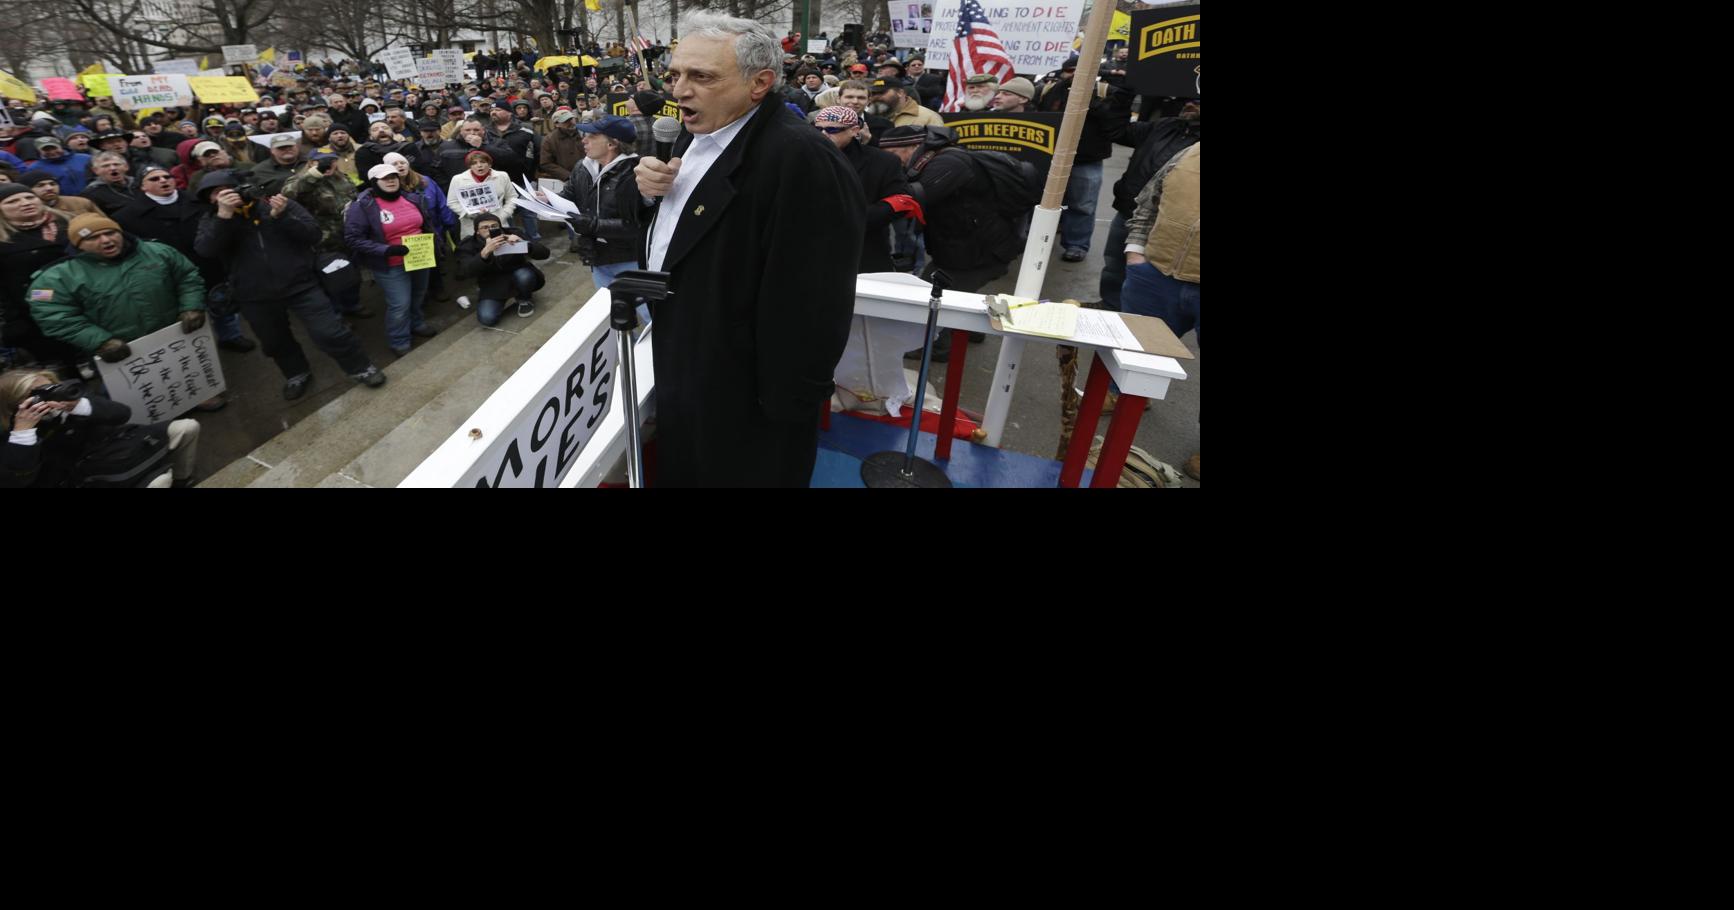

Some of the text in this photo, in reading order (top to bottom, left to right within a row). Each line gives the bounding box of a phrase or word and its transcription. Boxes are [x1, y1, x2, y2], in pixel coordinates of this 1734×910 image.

[1015, 7, 1030, 18] TO
[1032, 6, 1068, 18] DIE
[1000, 21, 1043, 33] AMENDMENT
[1151, 23, 1196, 47] OATH
[930, 38, 948, 48] ARE
[1025, 40, 1041, 51] TO
[1044, 41, 1071, 52] DIE
[1017, 54, 1043, 66] FROM
[118, 78, 143, 88] From
[955, 124, 1045, 144] ATH KEEPERS
[179, 355, 192, 373] the
[124, 357, 150, 385] FOR
[138, 381, 153, 400] the
[143, 348, 183, 410] By the People
[184, 371, 202, 400] People
[475, 328, 611, 488] MORE
[534, 372, 611, 488] IES
